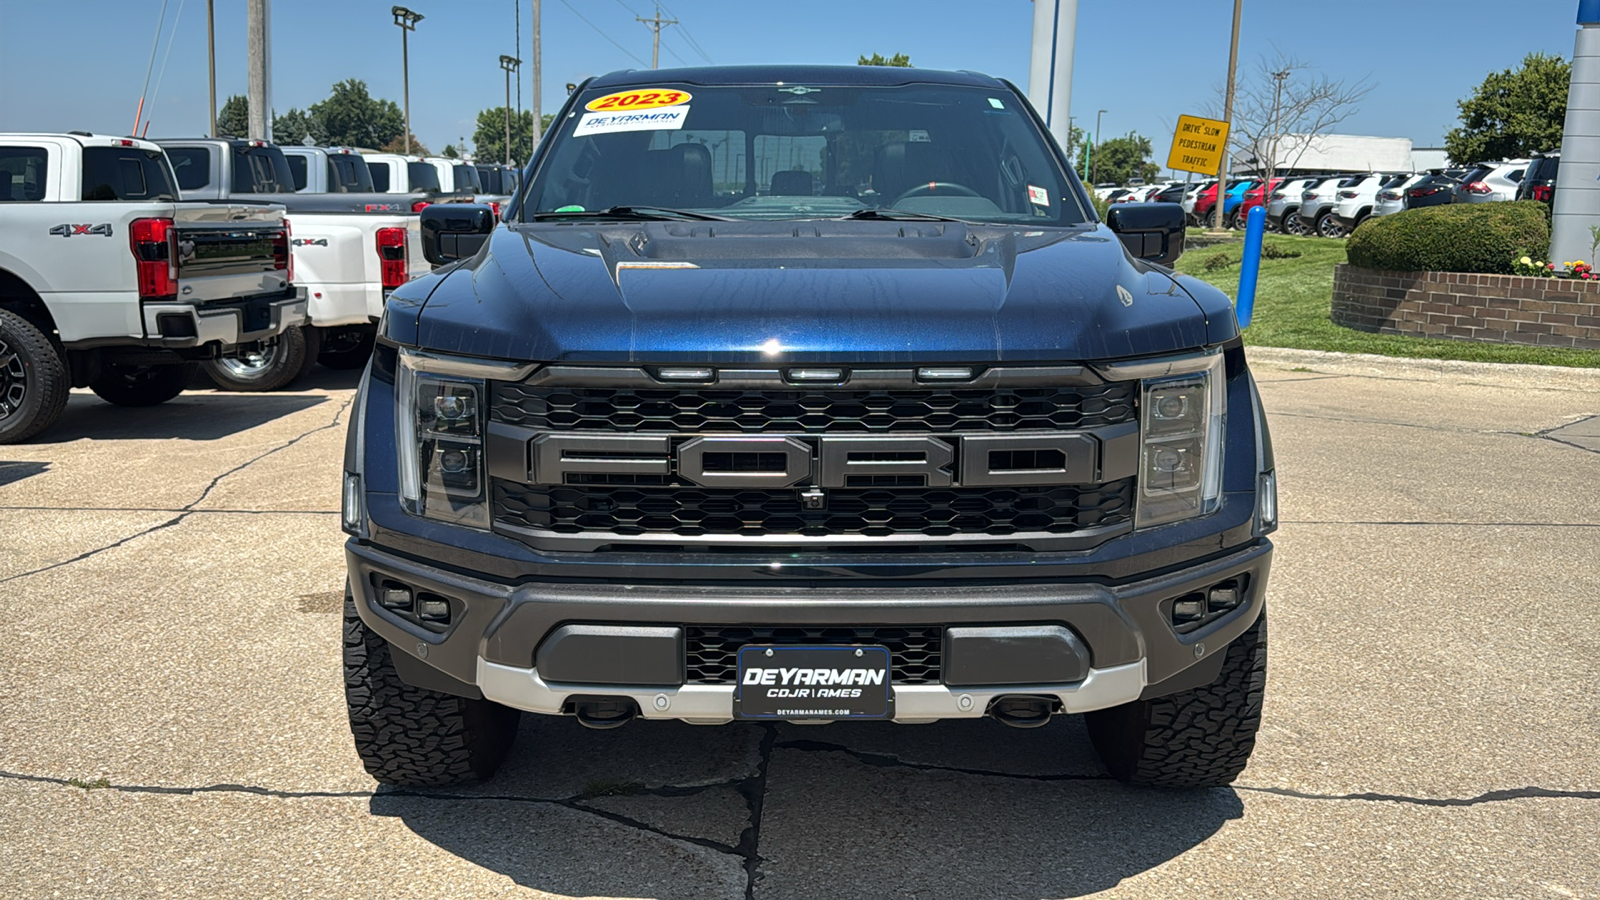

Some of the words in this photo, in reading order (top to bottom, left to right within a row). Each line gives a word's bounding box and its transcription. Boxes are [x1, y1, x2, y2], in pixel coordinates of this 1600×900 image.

[595, 93, 682, 109] 2023
[585, 112, 681, 126] DEYARMAN
[1182, 123, 1201, 134] DRIVE
[1204, 126, 1221, 137] SLOW
[1178, 138, 1217, 152] PEDESTRIAN
[1182, 155, 1207, 167] TRAFFIC
[365, 204, 400, 213] FX4
[533, 432, 1098, 489] FORD
[742, 667, 886, 686] DEYARMAN
[766, 688, 812, 698] CDJR
[816, 688, 863, 698] AMES
